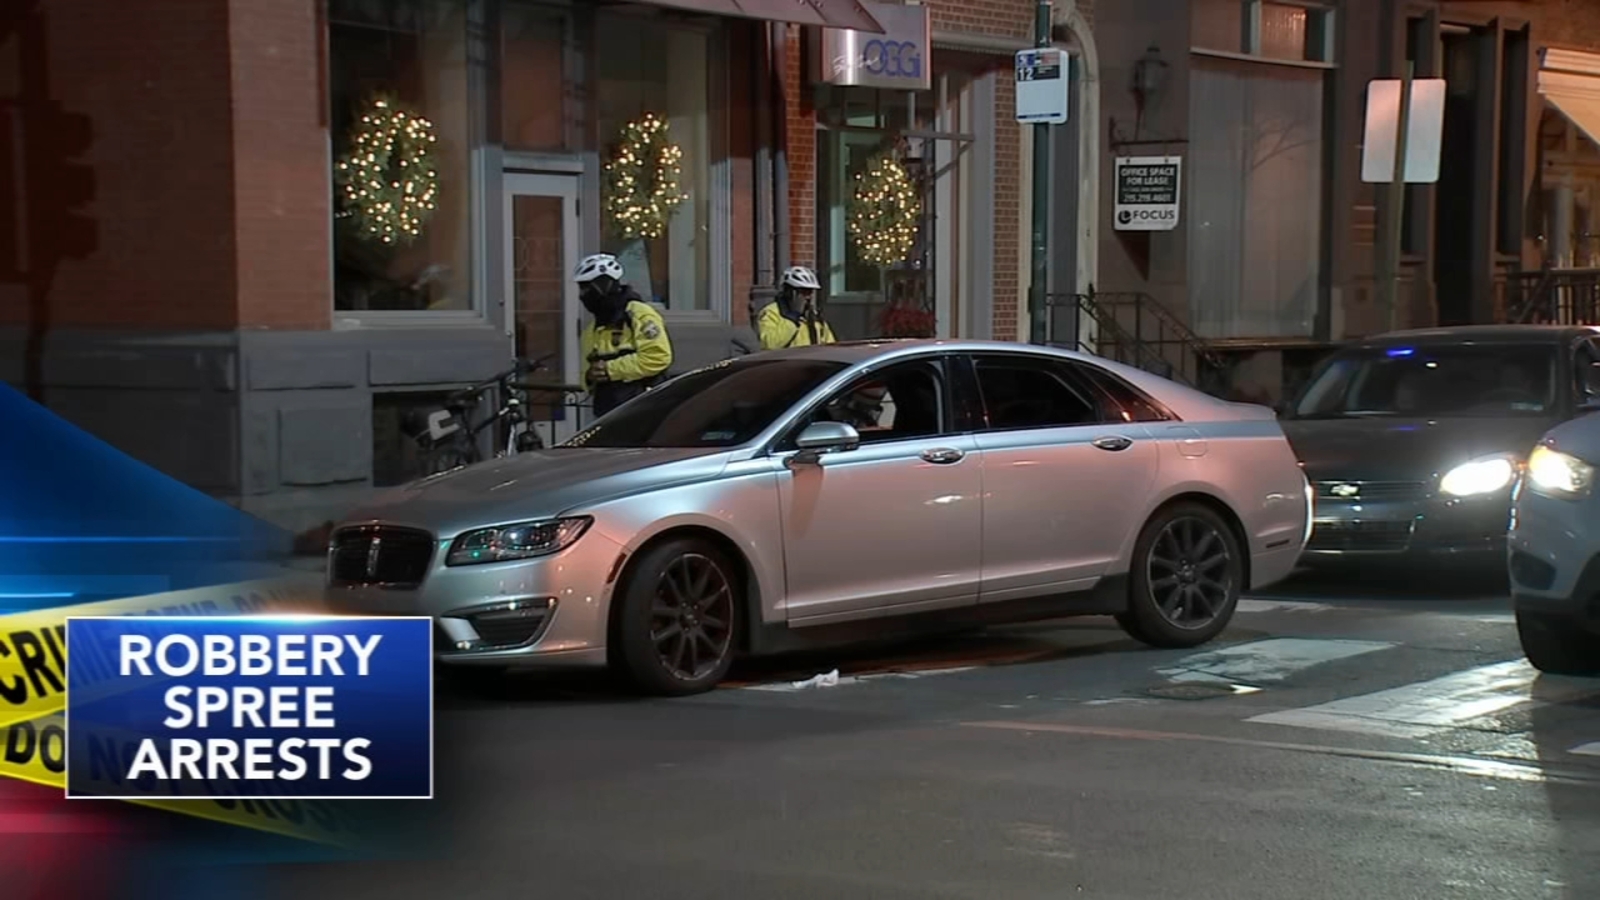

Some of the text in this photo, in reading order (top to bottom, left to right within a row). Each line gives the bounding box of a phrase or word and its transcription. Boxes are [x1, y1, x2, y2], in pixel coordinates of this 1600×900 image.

[1019, 67, 1035, 81] 12
[1121, 167, 1175, 176] OFFICE SPACE
[1126, 177, 1168, 185] FOR LEASE
[1133, 210, 1175, 220] FOCUS
